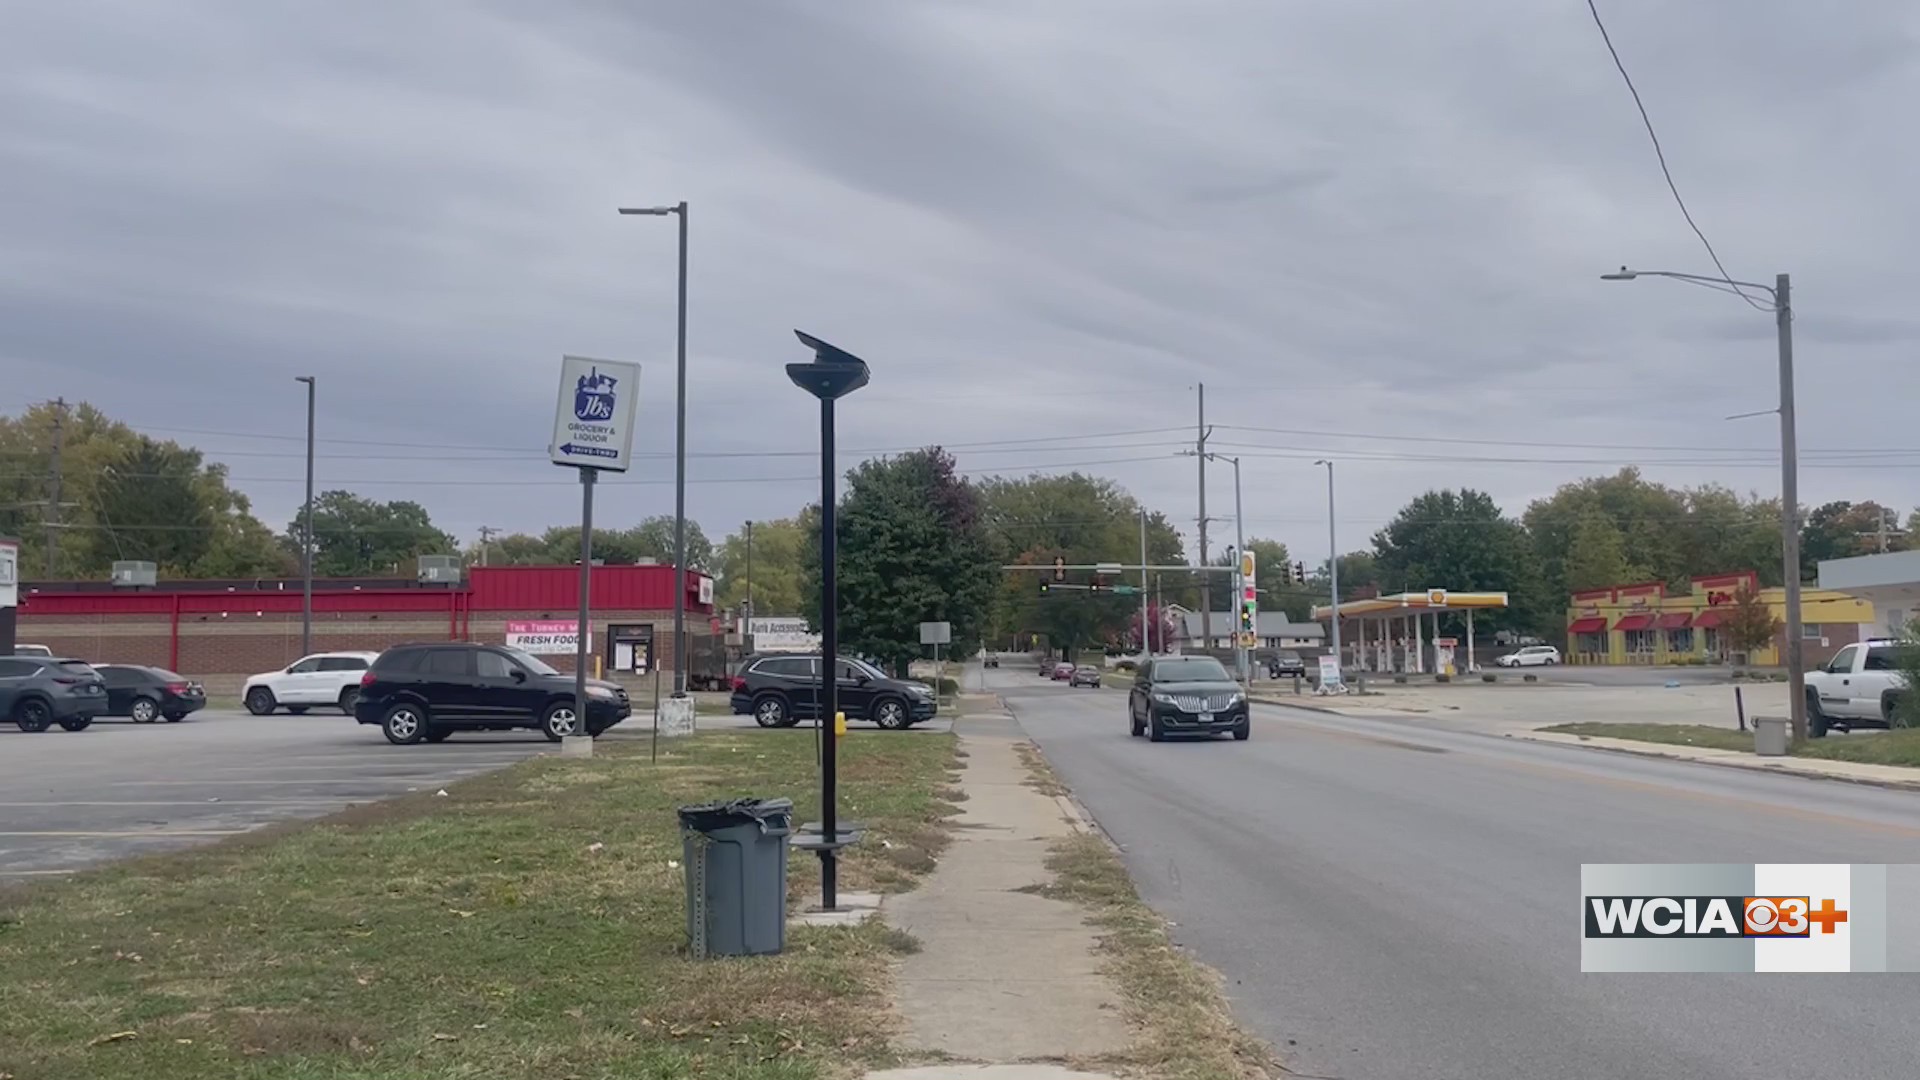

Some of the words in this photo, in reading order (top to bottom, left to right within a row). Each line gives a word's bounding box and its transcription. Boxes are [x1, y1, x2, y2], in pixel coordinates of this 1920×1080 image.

[568, 423, 608, 434] GROCERY
[574, 433, 607, 442] LIQUOR
[517, 635, 551, 645] FRESH
